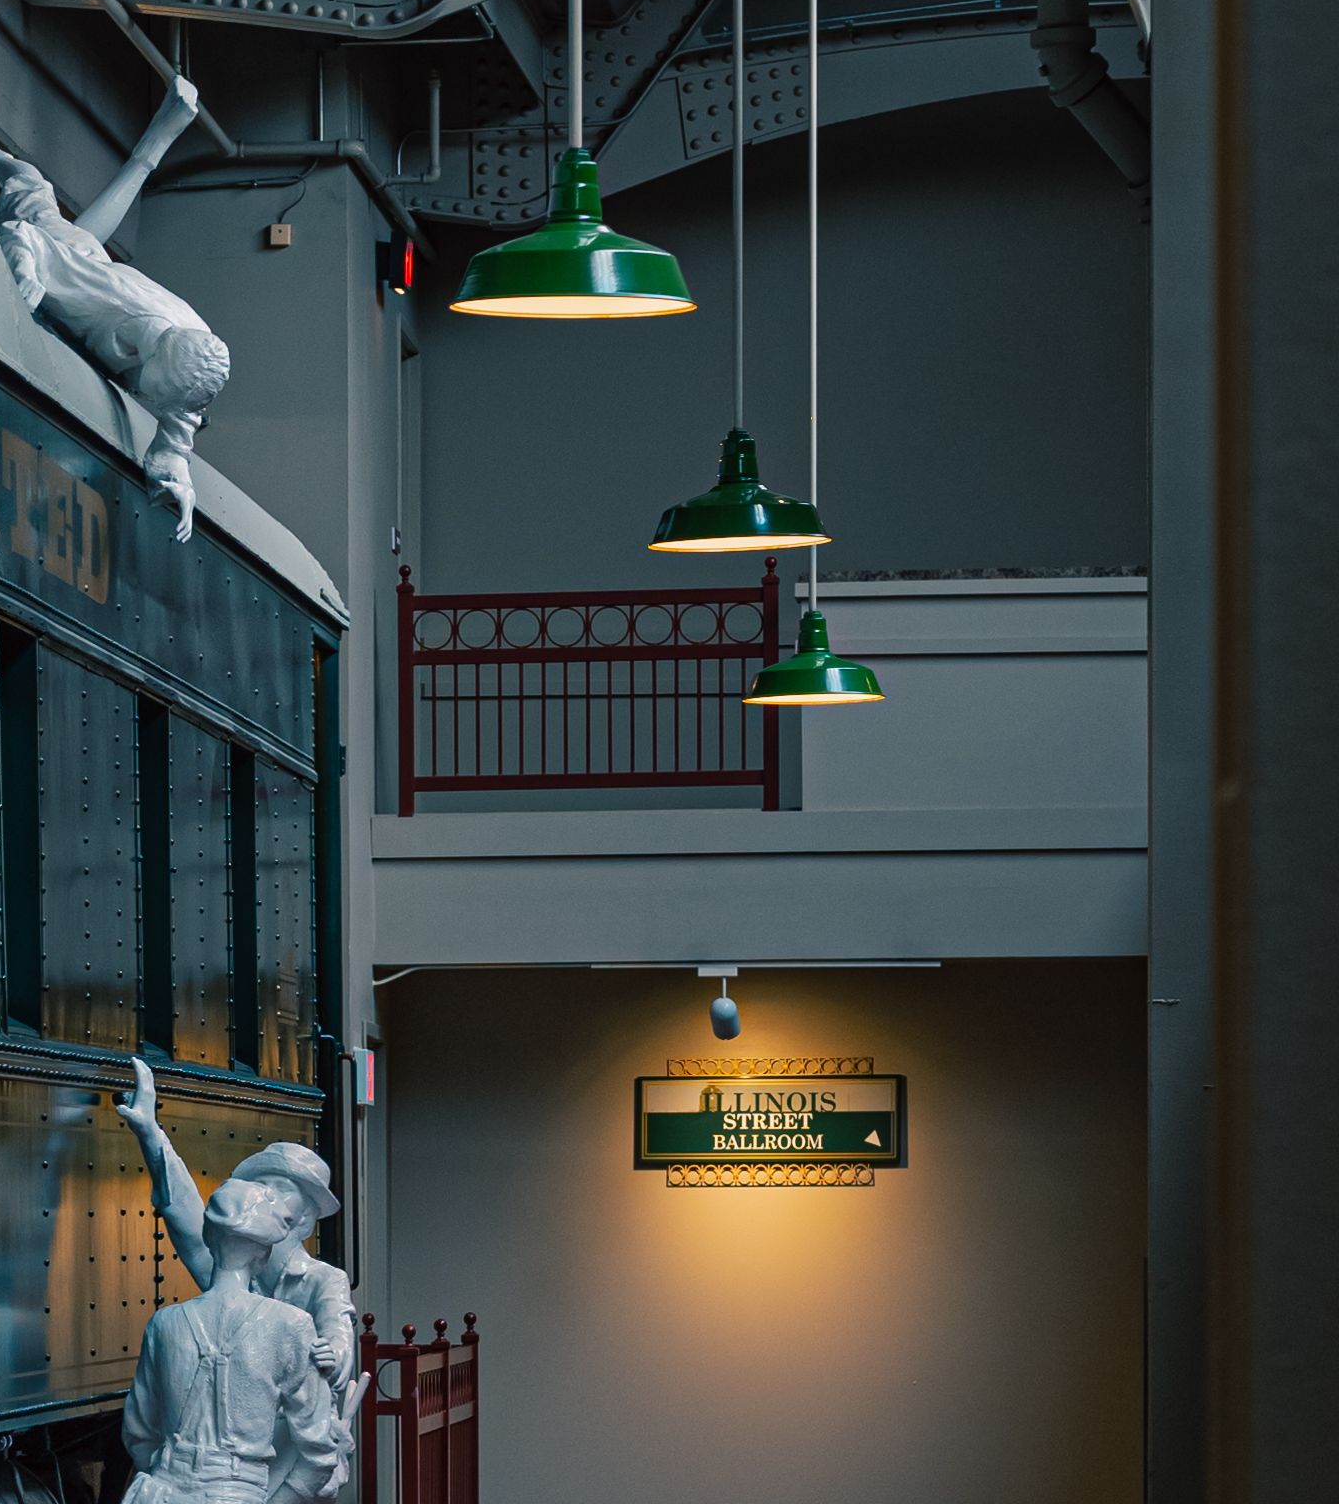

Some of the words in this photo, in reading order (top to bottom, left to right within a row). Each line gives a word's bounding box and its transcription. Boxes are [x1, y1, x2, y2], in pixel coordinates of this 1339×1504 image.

[702, 1092, 837, 1112] ILLINOIS
[723, 1112, 814, 1130] STREET
[713, 1133, 824, 1150] BALLROOM
